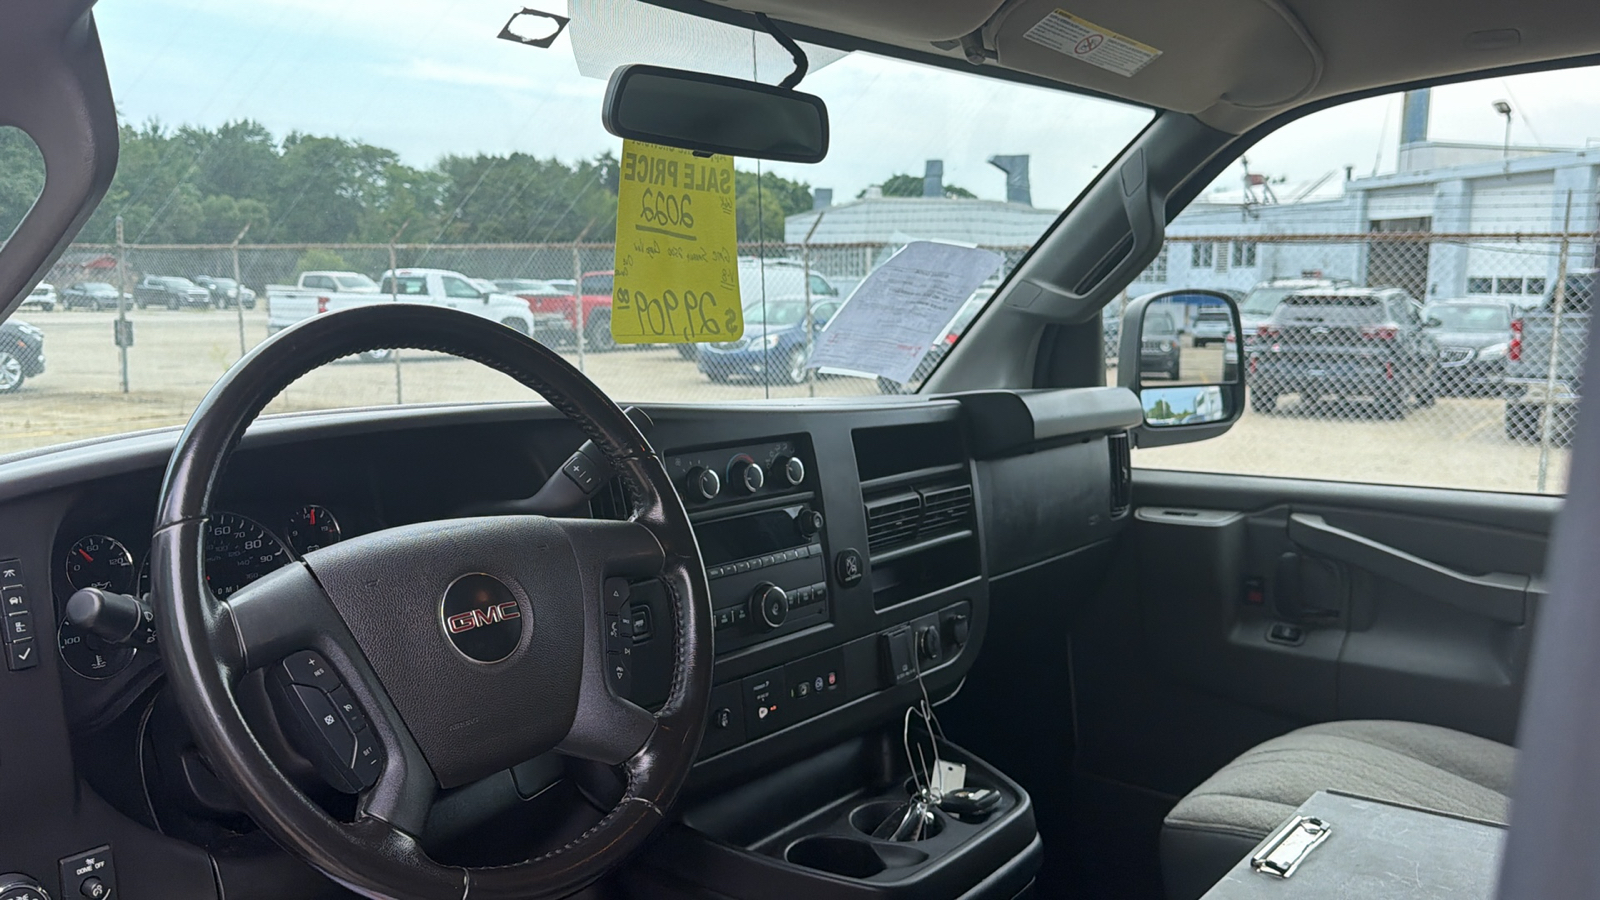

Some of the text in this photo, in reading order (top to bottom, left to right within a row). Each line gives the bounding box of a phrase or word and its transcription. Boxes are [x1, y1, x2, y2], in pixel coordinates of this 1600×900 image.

[214, 525, 231, 536] 60
[233, 531, 246, 539] 70
[86, 544, 99, 552] 60
[244, 539, 262, 550] 80
[109, 557, 124, 566] 120
[260, 554, 273, 563] 90
[73, 564, 81, 572] 0
[447, 601, 521, 634] GMC
[64, 636, 81, 646] 100
[76, 860, 105, 875] DOME OFF
